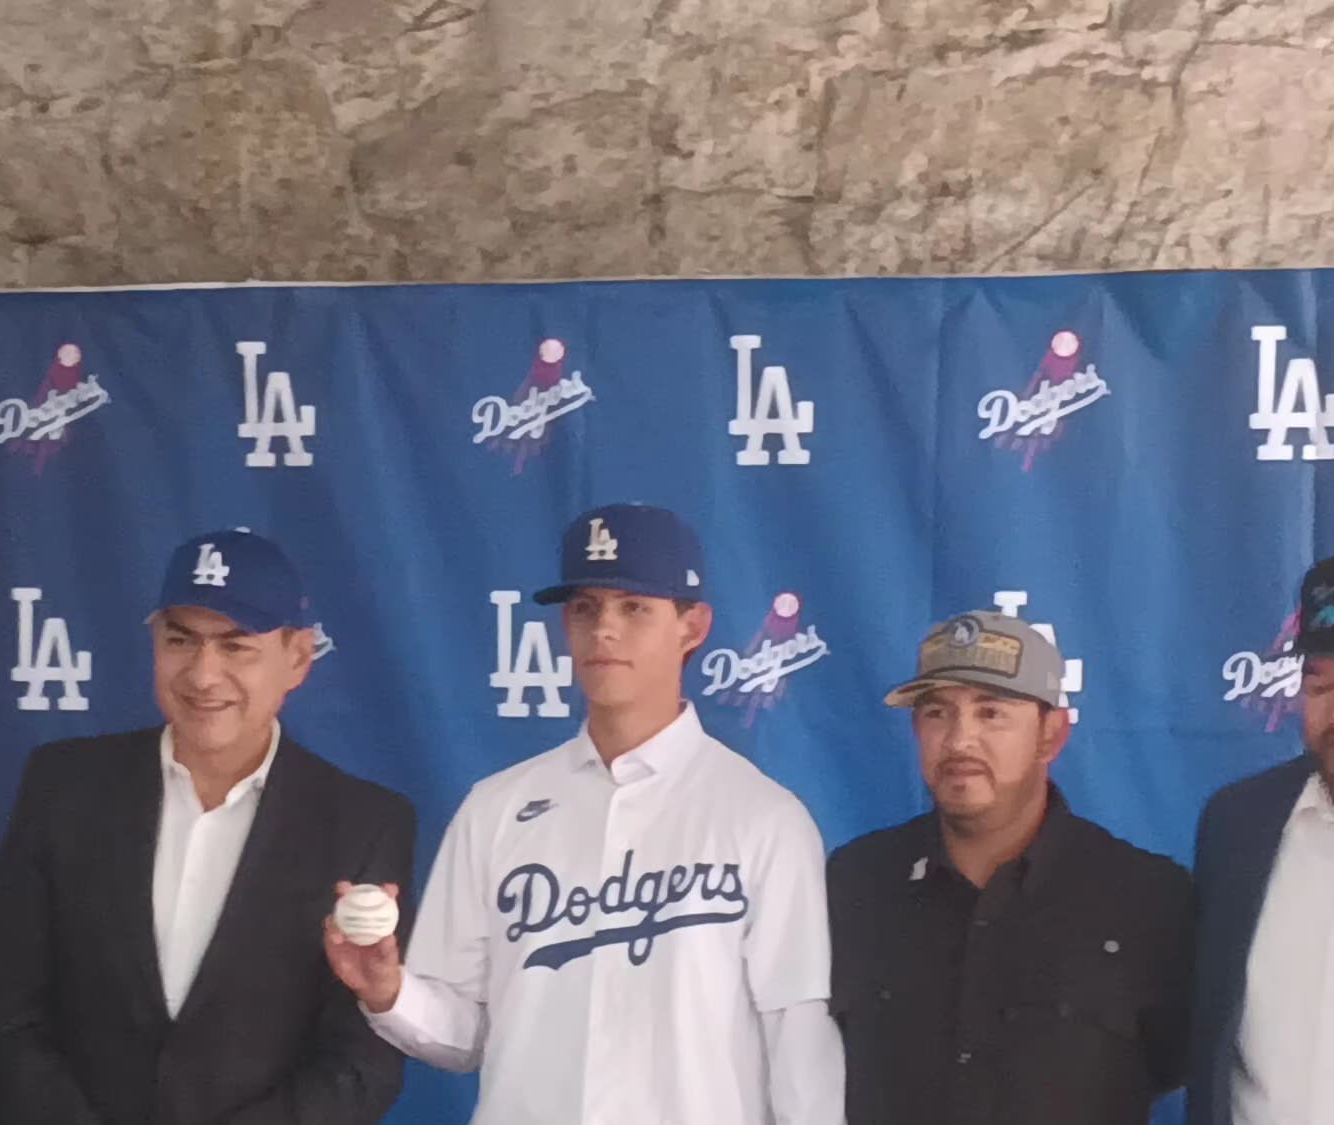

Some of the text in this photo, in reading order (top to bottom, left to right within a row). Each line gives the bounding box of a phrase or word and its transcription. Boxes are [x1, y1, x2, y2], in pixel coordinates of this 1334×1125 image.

[235, 341, 315, 467] LA
[473, 370, 597, 443] Dodgers
[728, 334, 814, 465] LA
[977, 364, 1111, 440] Dodgers
[193, 543, 230, 586] LA
[586, 518, 617, 561] LA
[11, 587, 92, 711] LA
[490, 590, 573, 718] LA
[701, 624, 831, 697] Dodgers
[497, 850, 750, 970] Dodgers
